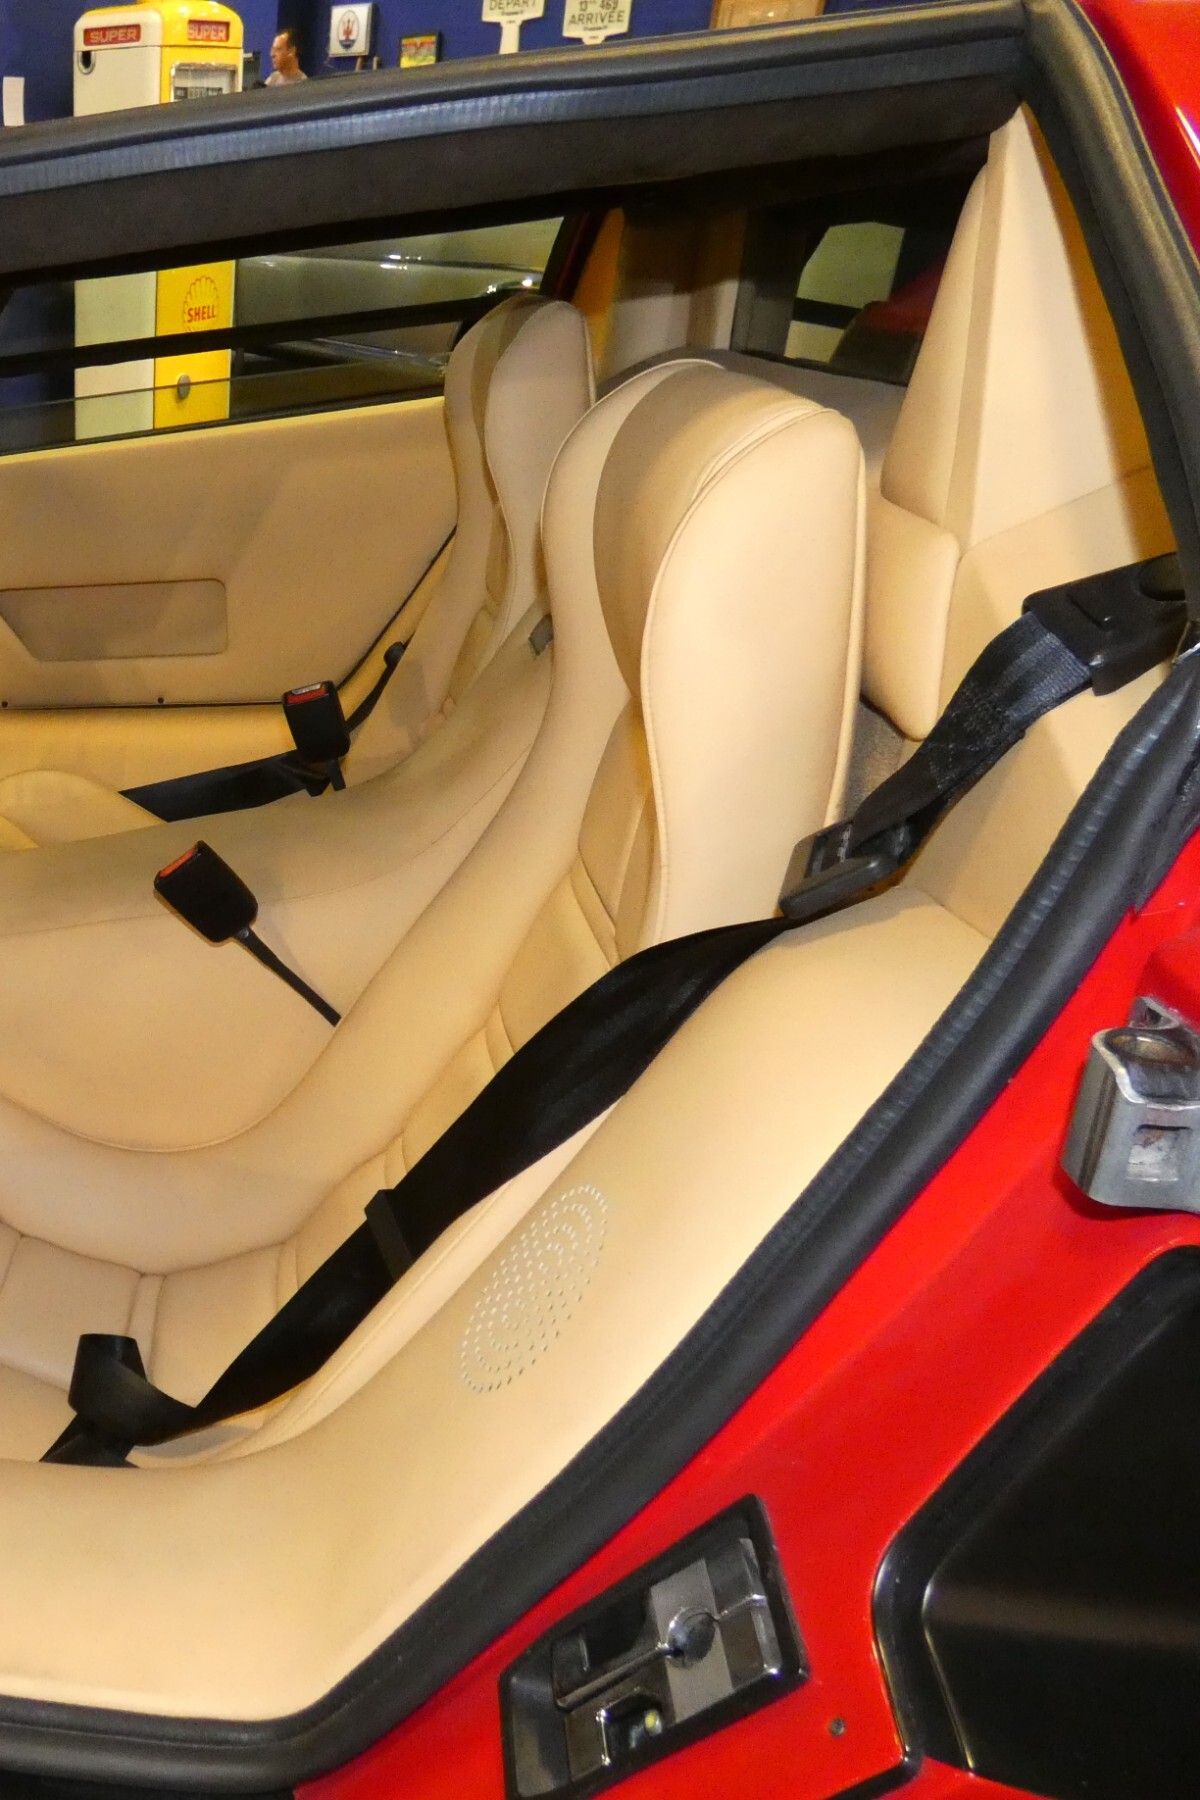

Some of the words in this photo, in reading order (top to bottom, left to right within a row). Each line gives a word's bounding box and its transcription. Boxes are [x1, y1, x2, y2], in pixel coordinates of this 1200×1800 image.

[569, 10, 625, 25] ARRIVÉE
[90, 29, 137, 43] SUPER
[188, 23, 226, 40] SUPER
[187, 304, 216, 323] SHELL
